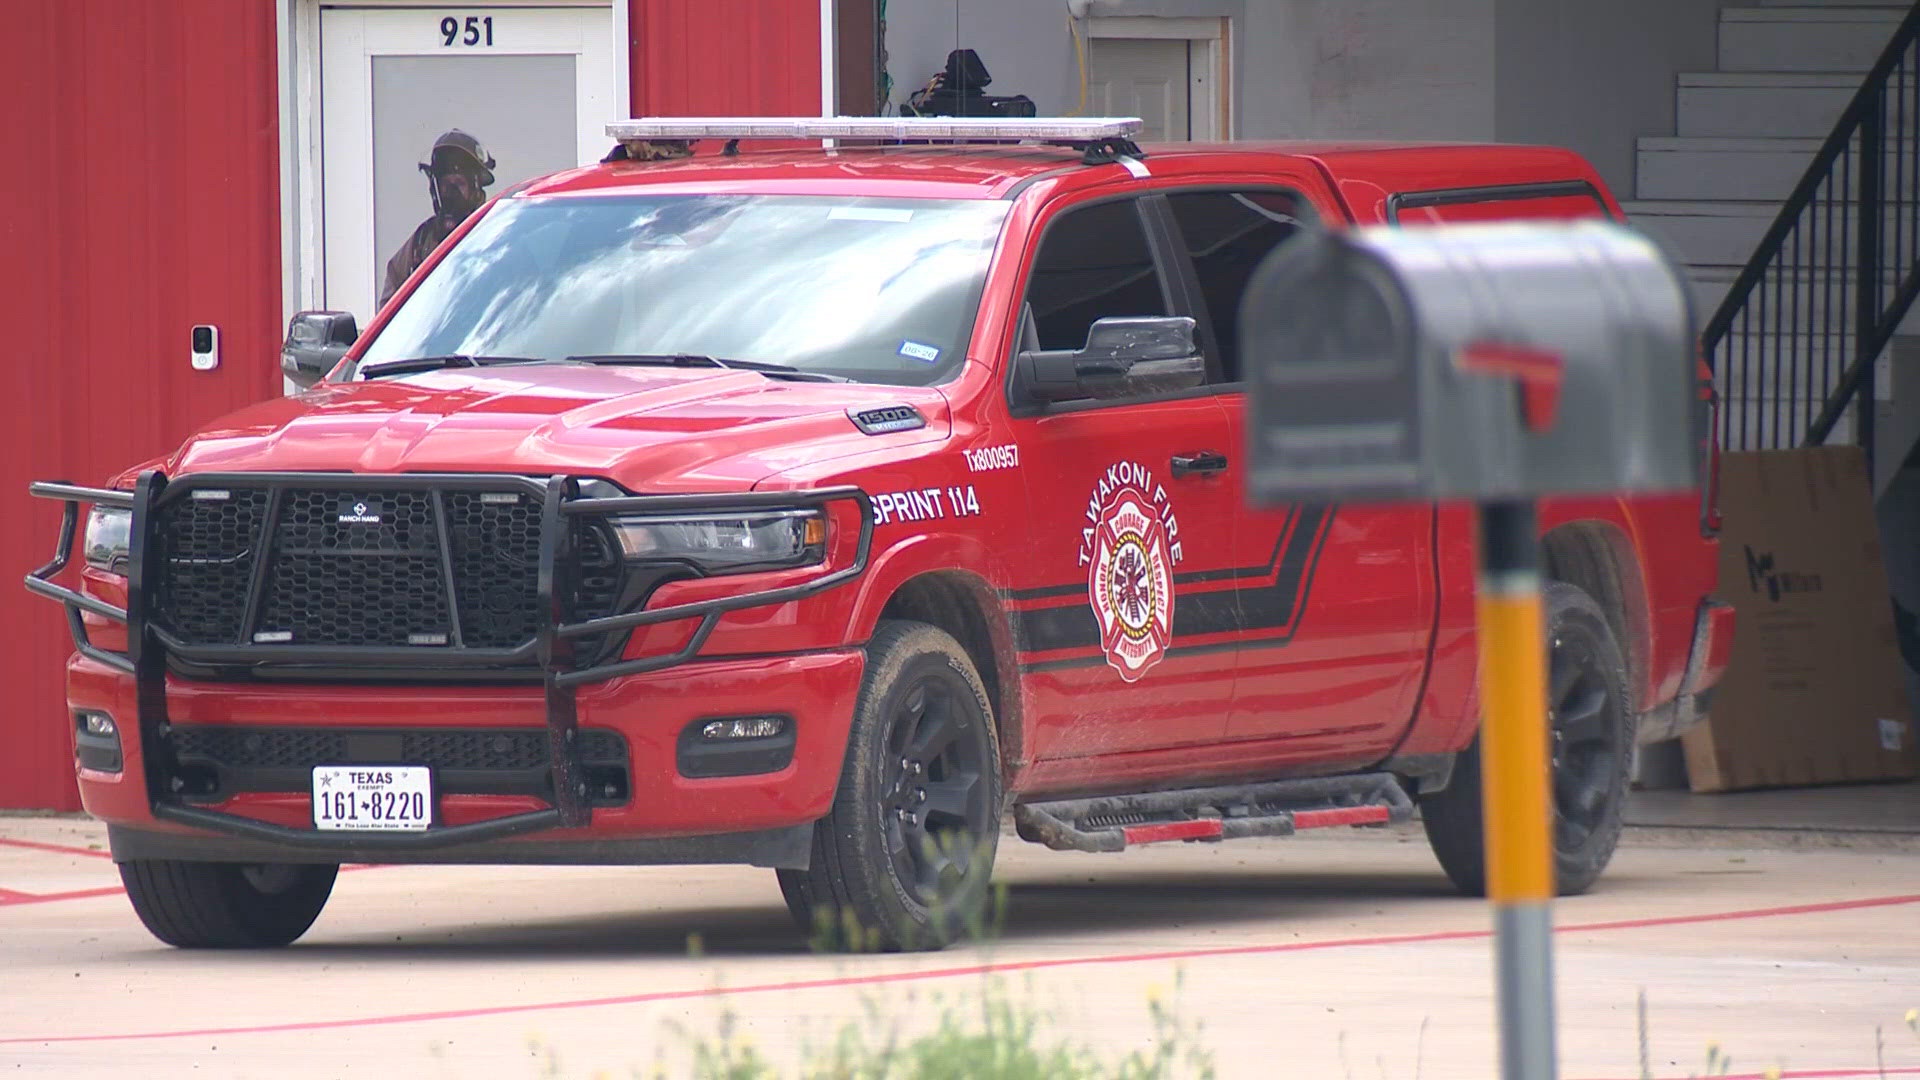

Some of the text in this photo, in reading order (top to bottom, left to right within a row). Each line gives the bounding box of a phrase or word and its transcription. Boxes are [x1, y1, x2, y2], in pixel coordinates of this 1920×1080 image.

[441, 16, 493, 46] 951
[860, 408, 911, 424] 1500
[963, 445, 1019, 472] Tx800957
[869, 485, 981, 525] SPRINT 114
[1078, 460, 1184, 568] TAWAKONI FIRE
[1115, 513, 1145, 534] COURAGE
[1152, 552, 1165, 616] RESPECT
[349, 772, 393, 784] TEXAS
